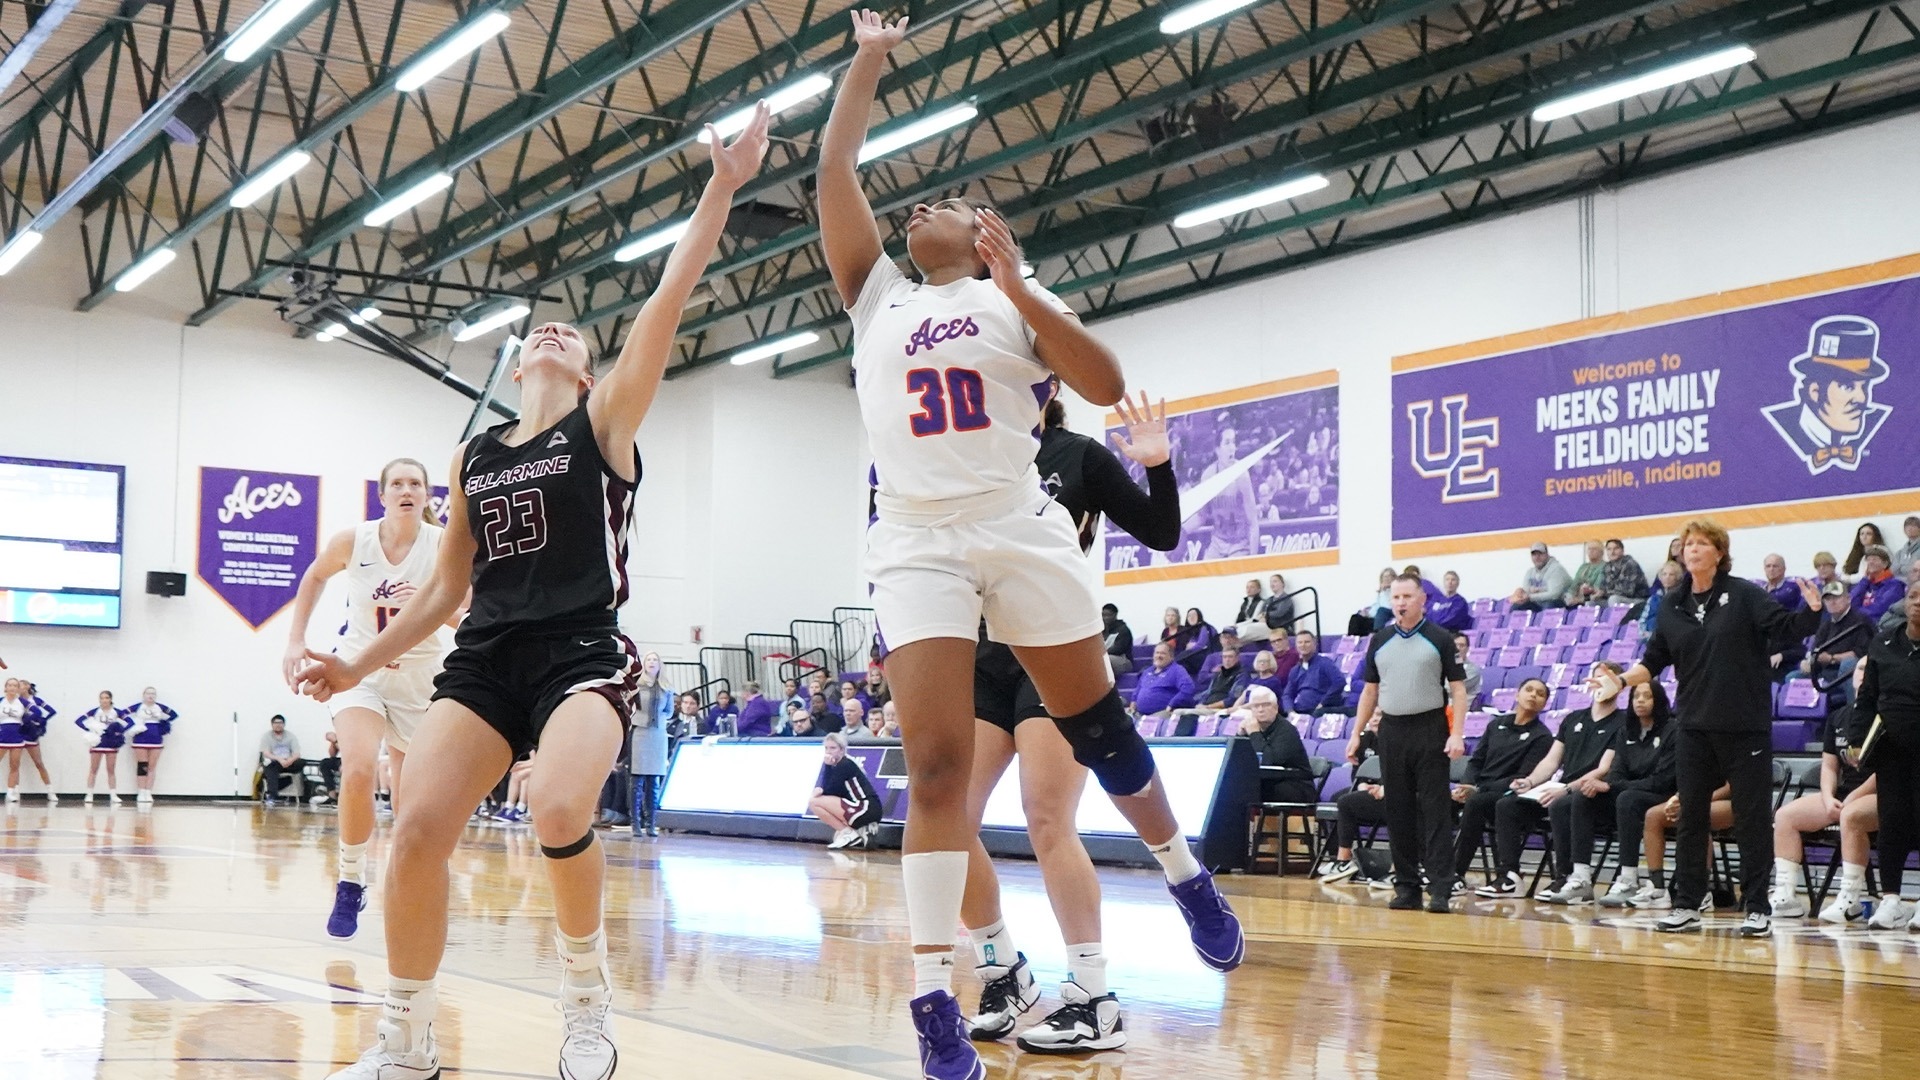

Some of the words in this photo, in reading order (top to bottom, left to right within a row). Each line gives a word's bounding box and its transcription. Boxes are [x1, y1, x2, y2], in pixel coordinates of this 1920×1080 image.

[905, 316, 980, 357] Aces
[1572, 358, 1656, 386] Welcome
[1661, 353, 1681, 372] to
[906, 367, 991, 437] 30
[1536, 385, 1620, 433] MEEKS
[1627, 368, 1721, 420] FAMILY
[1407, 393, 1499, 504] UE
[1554, 414, 1710, 471] FIELDHOUSE
[217, 476, 302, 523] Aces
[1545, 468, 1640, 496] Evansville,
[1645, 460, 1722, 484] Indiana
[222, 542, 269, 554] CONFERENCE
[255, 532, 299, 544] BASKETBALL
[480, 488, 547, 561] 23
